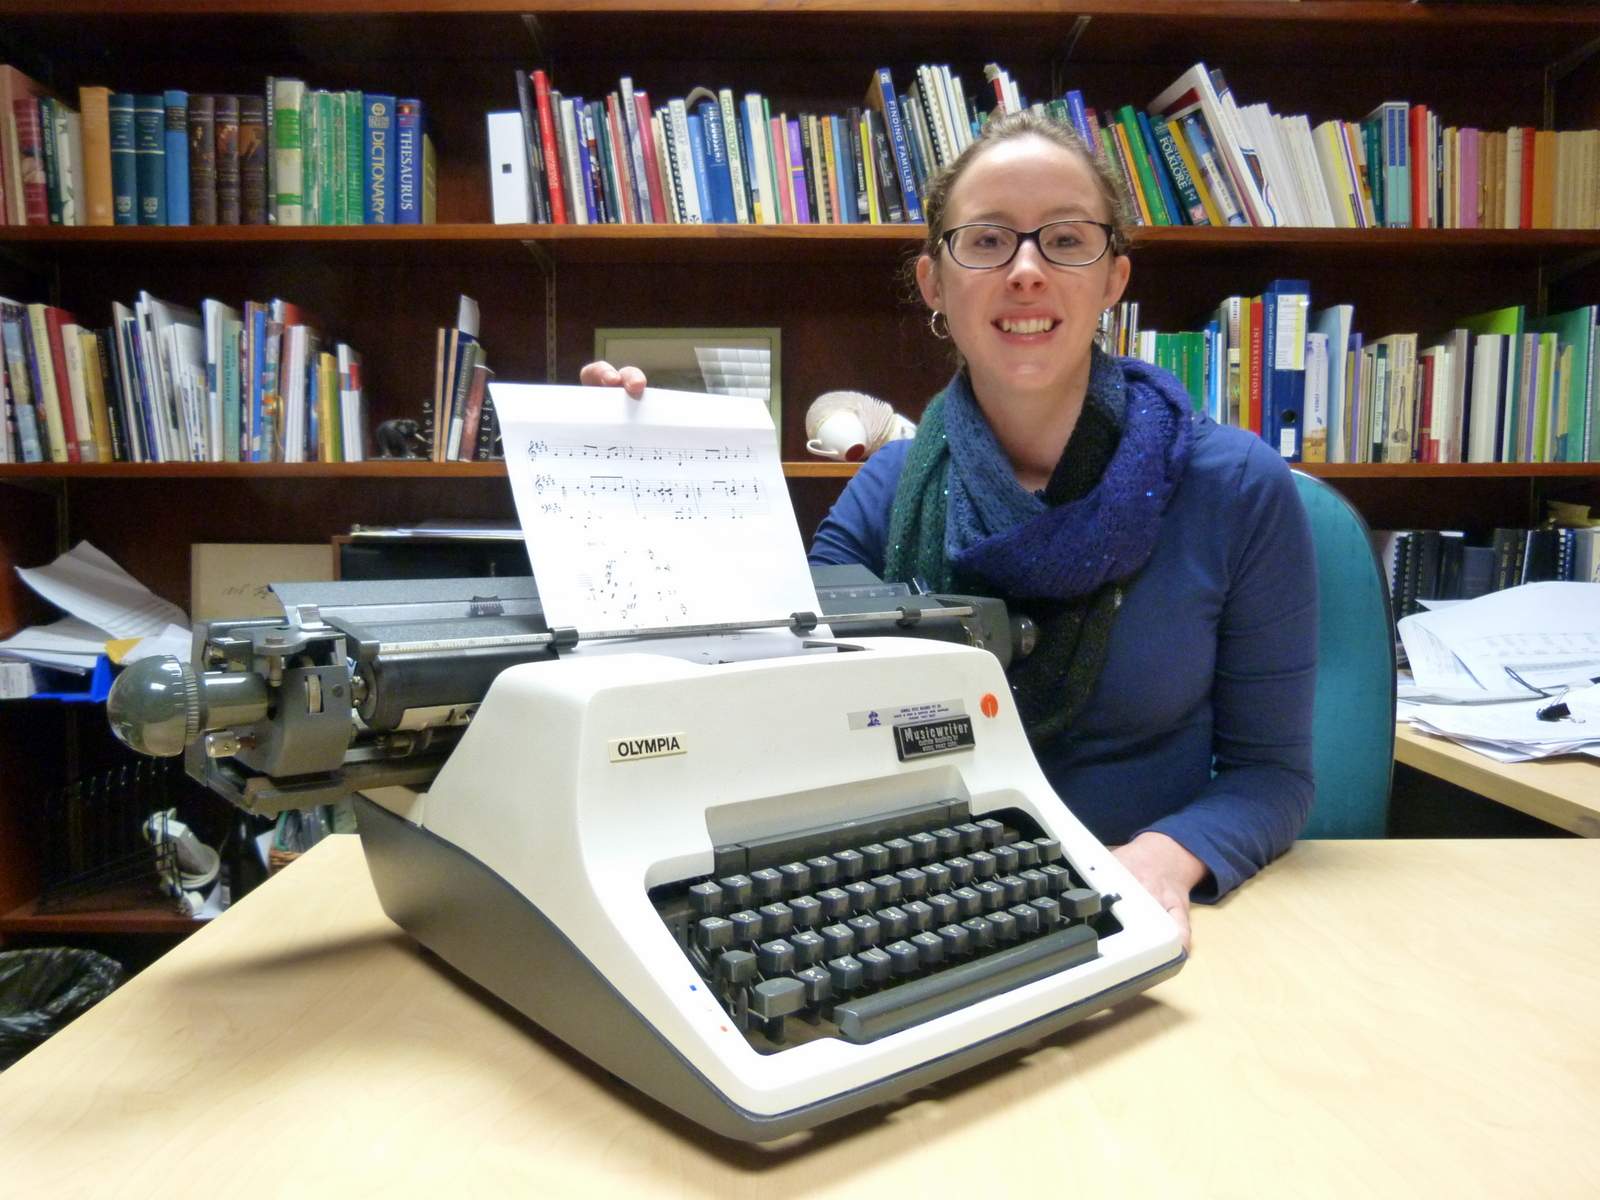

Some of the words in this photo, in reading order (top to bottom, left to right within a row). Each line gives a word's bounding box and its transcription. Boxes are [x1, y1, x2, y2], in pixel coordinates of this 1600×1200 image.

[371, 131, 385, 215] DICTIONARY
[401, 132, 413, 211] THESAURUS
[889, 100, 903, 142] FINDING
[898, 145, 914, 193] FAMILIES
[1160, 137, 1188, 190] FOLKLORE
[618, 736, 680, 757] OLYMPIA
[904, 722, 968, 742] Musicwriter
